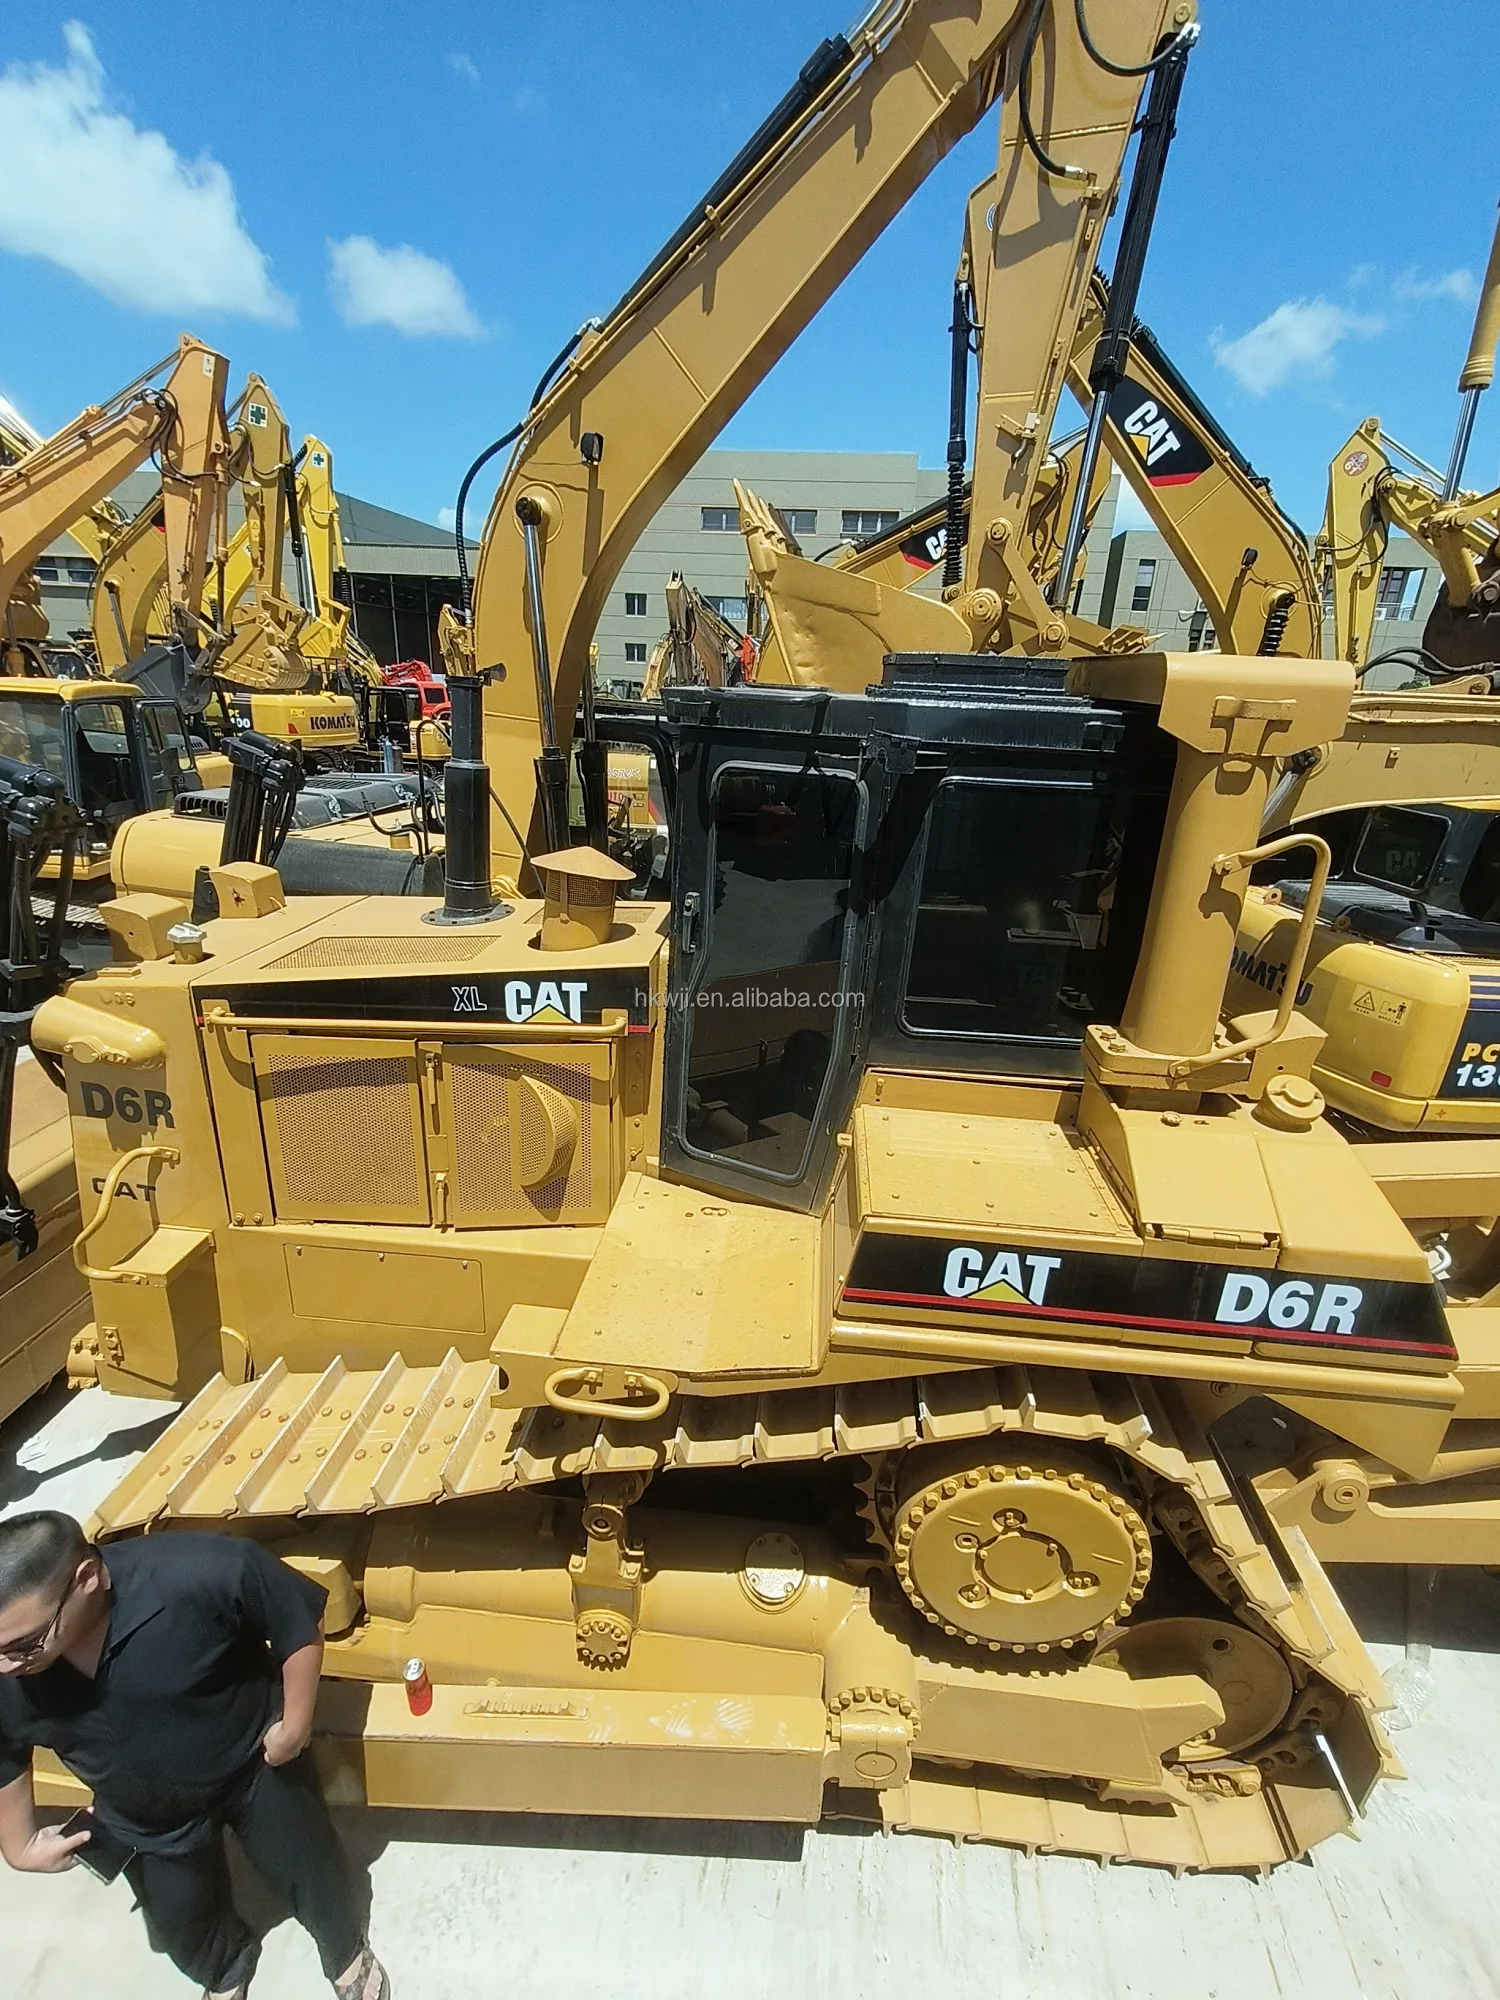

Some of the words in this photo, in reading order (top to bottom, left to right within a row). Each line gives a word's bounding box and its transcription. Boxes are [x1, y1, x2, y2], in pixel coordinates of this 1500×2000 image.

[1124, 401, 1181, 466] CAT
[926, 529, 947, 560] CA
[228, 709, 240, 718] PC
[310, 713, 356, 730] KOMATSU
[452, 986, 487, 1011] XL
[504, 980, 588, 1024] CAT
[1461, 1043, 1500, 1062] PC
[1457, 1063, 1500, 1087] 13
[81, 1081, 175, 1129] D6R
[943, 1247, 1061, 1306] CAT
[1215, 1272, 1363, 1335] D6R
